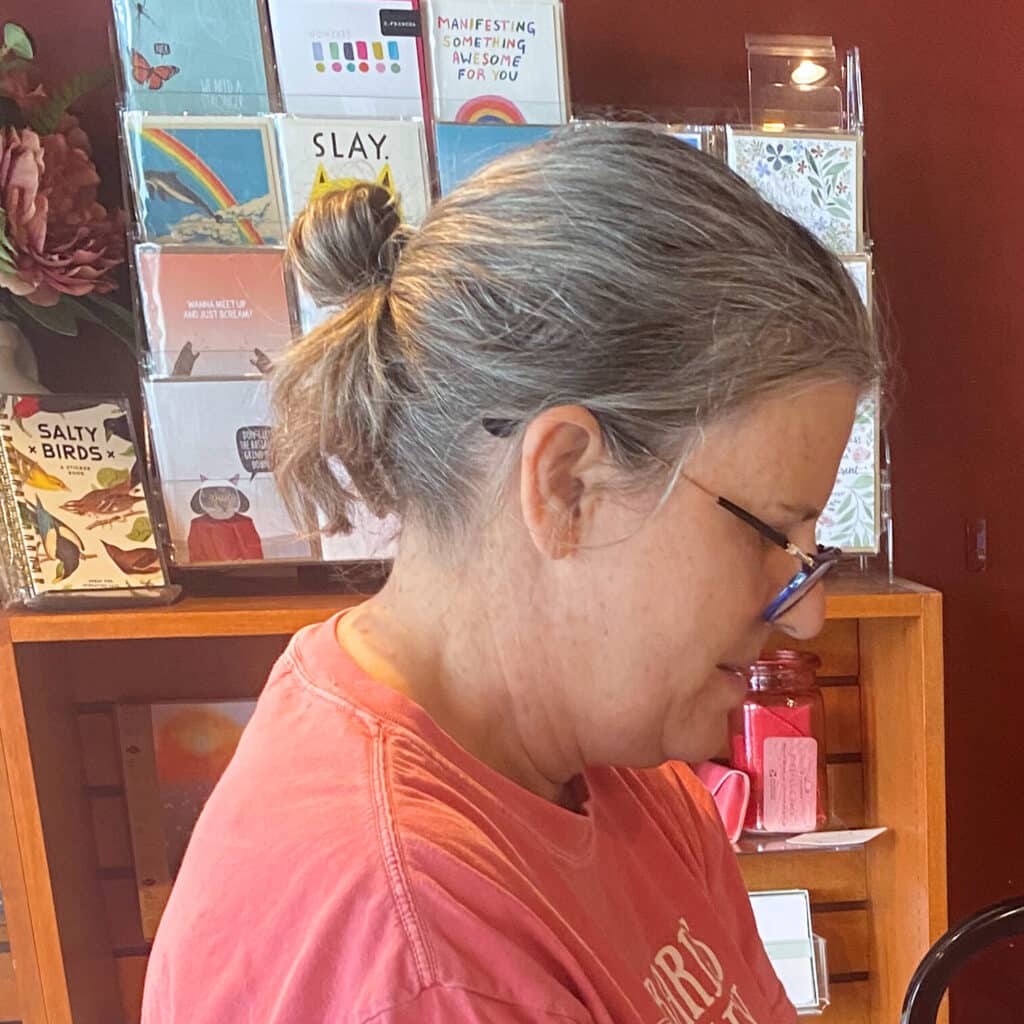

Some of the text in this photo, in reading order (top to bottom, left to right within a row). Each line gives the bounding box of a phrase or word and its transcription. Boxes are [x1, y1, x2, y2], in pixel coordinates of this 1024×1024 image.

[438, 16, 536, 36] MANIFESTING
[443, 36, 526, 54] SOMETHING
[452, 51, 521, 67] AWESOME
[458, 68, 518, 81] FOR YOU
[312, 132, 389, 160] SLAY.
[216, 300, 235, 309] MEET
[38, 423, 97, 442] SALTY
[42, 443, 103, 461] BIRDS
